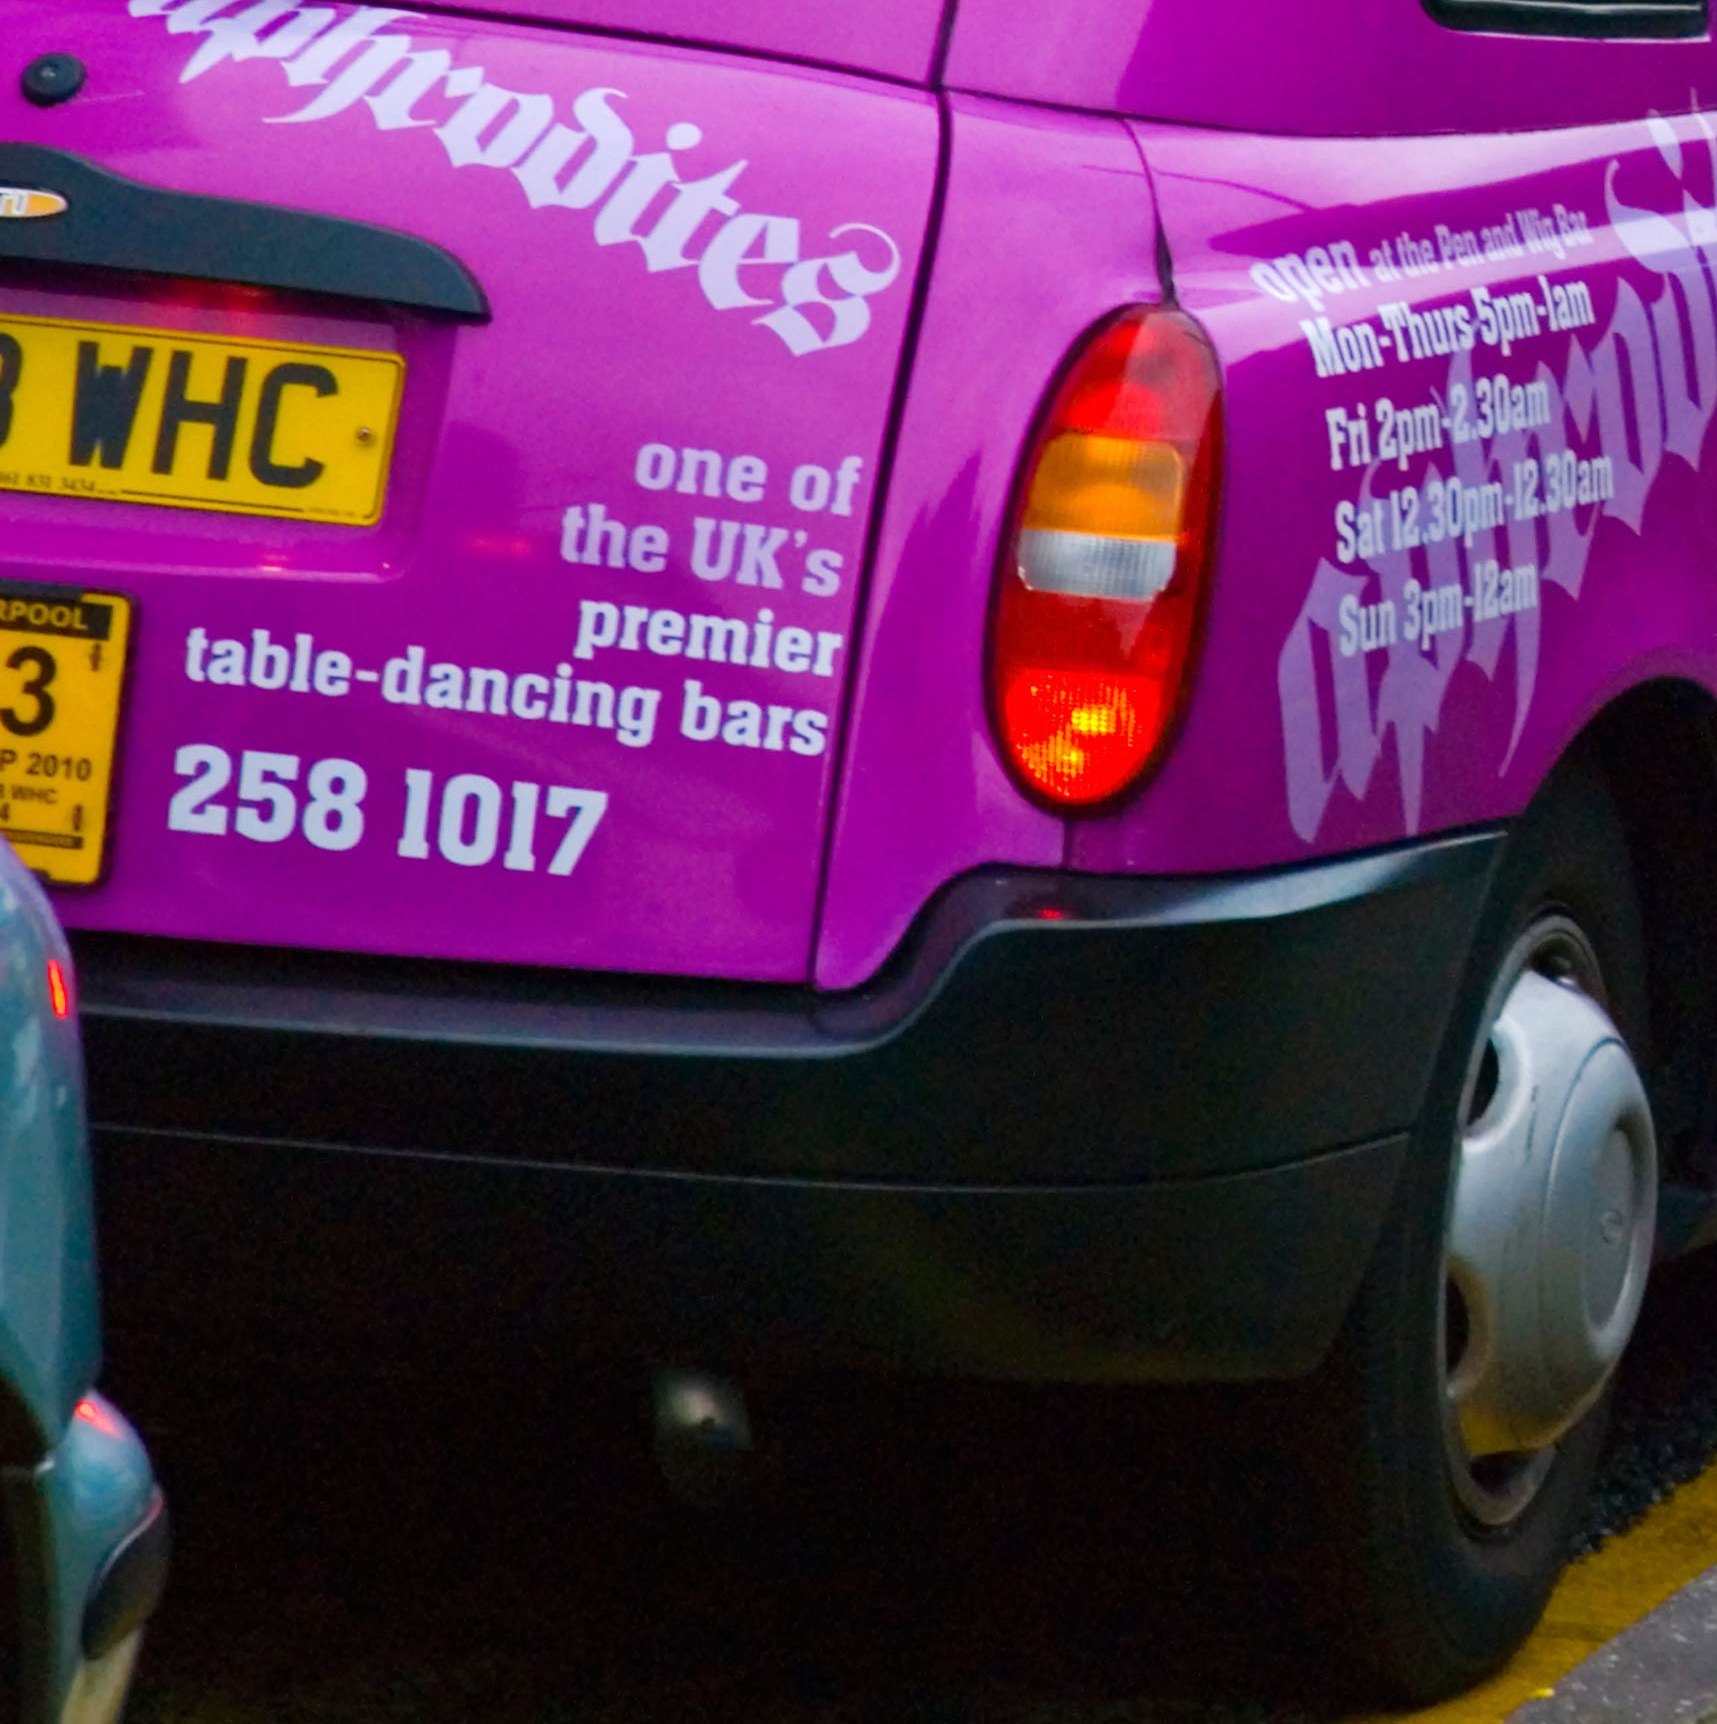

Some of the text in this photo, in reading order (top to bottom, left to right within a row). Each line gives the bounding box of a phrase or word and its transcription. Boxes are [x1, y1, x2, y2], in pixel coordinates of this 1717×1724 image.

[1249, 239, 1372, 313] open
[1369, 240, 1395, 283] at
[1396, 233, 1439, 278] the
[1434, 223, 1481, 271] Pen
[1480, 214, 1519, 265] and
[1300, 274, 1597, 379] Mon-Thurs 5pm-1am
[68, 339, 340, 490] WHC
[1325, 372, 1552, 472] Fri 2pm-2.30am
[634, 440, 865, 517] one of
[1334, 449, 1616, 565] Sat 12.30pm-12.30am
[559, 503, 846, 598] the UK's
[572, 598, 845, 678] premier
[1337, 560, 1538, 658] Sun 3pm-12am
[184, 626, 830, 758] table-dancing bars
[25, 750, 93, 782] 2010
[166, 743, 610, 877] 258 1017
